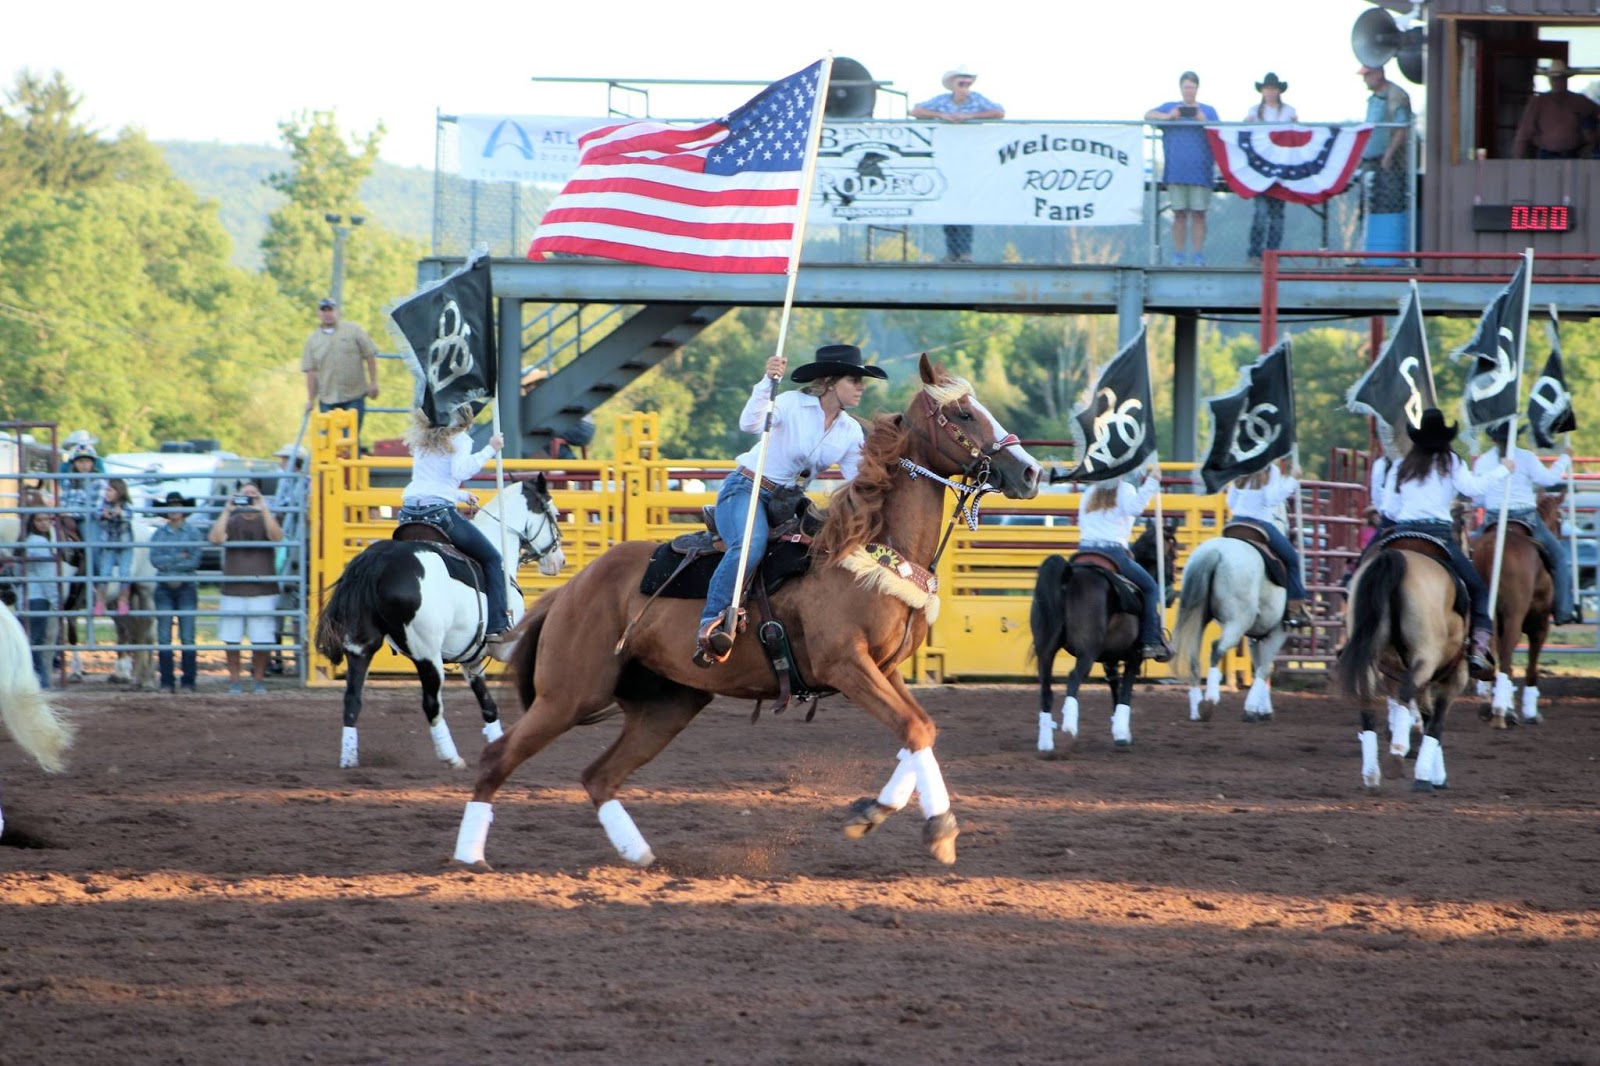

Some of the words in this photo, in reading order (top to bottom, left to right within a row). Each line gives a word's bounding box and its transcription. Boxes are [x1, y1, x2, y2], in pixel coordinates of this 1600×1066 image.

[820, 127, 937, 149] BENTON
[998, 134, 1128, 166] Welcome
[818, 172, 934, 197] RODEO
[1023, 169, 1113, 191] RODEO
[1034, 197, 1095, 221] Fans
